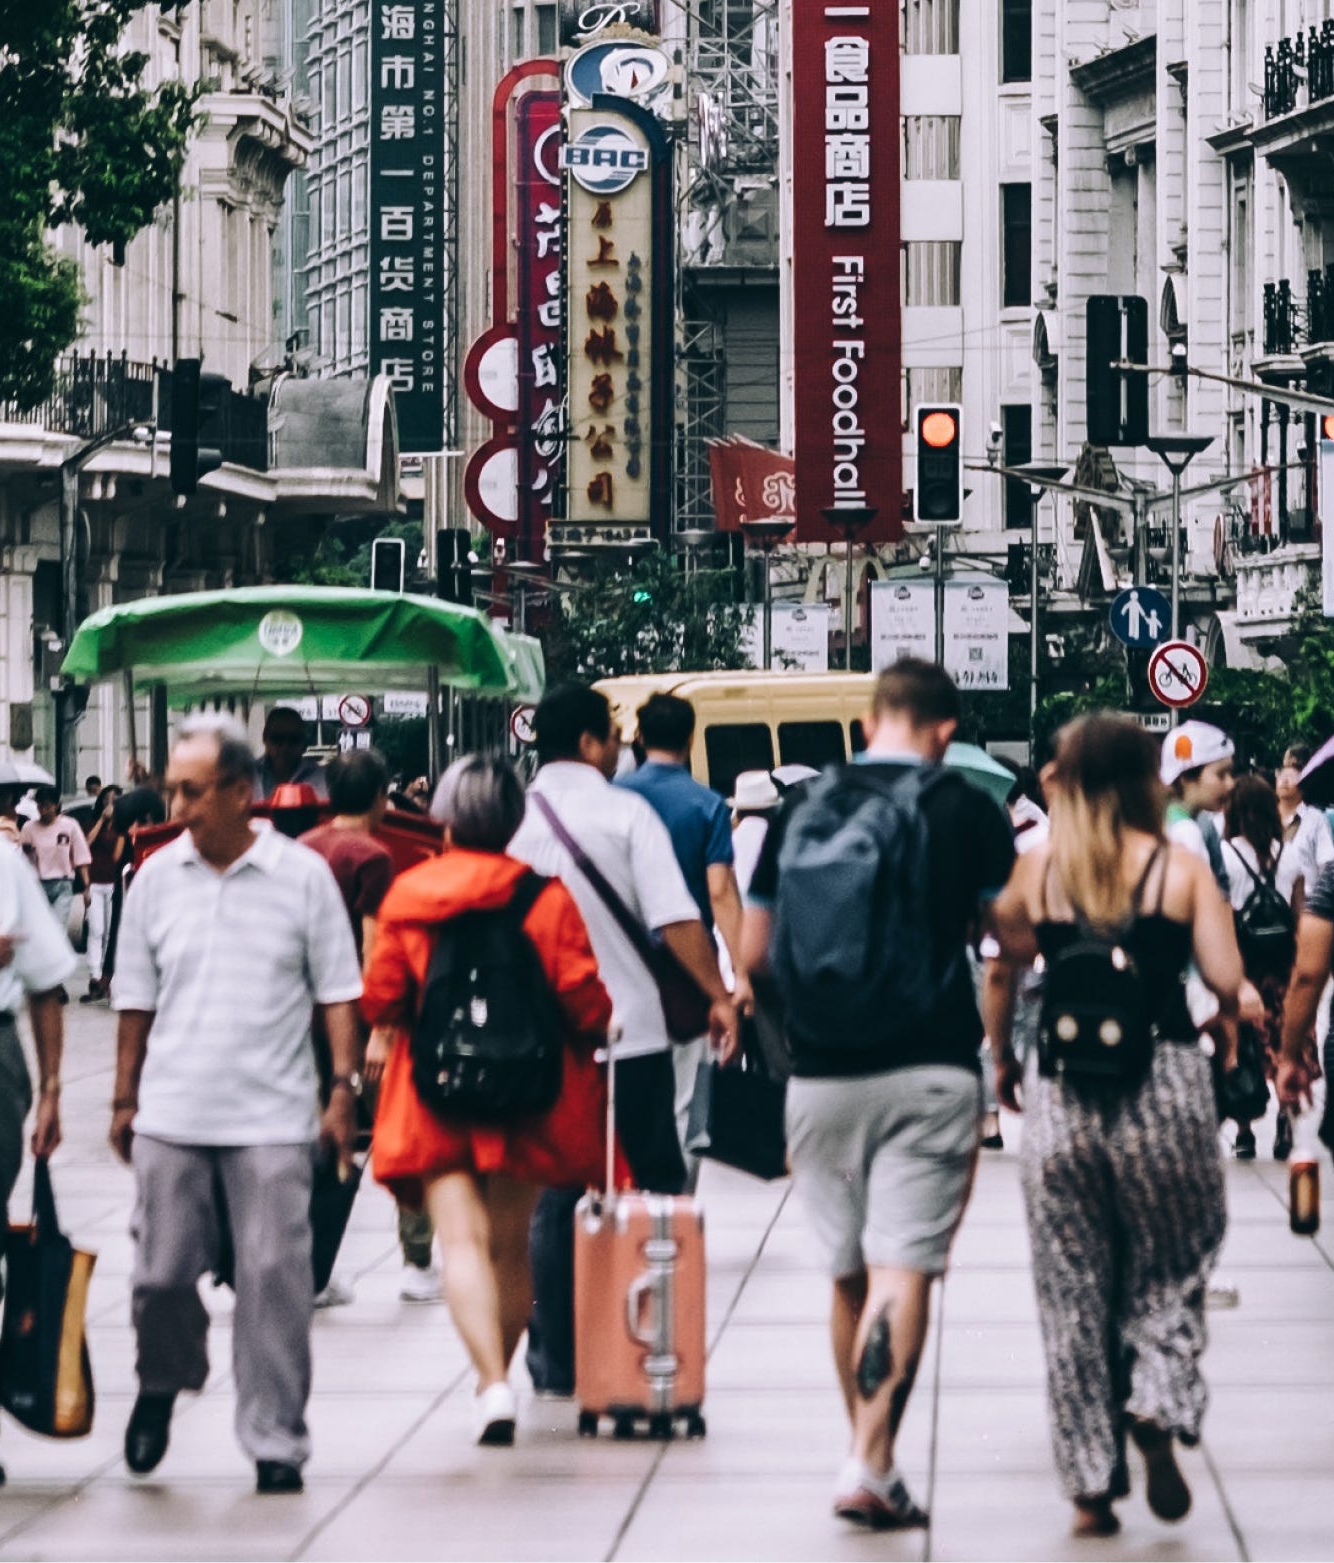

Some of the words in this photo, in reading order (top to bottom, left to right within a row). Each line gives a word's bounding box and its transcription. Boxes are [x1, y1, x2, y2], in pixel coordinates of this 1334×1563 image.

[422, 90, 435, 135] NO.1
[824, 7, 870, 227] 一食品商店
[565, 147, 646, 169] BAC
[422, 155, 435, 303] DEPARTMENT
[831, 256, 865, 330] First
[422, 320, 435, 393] STORE
[831, 340, 867, 509] Foodhall
